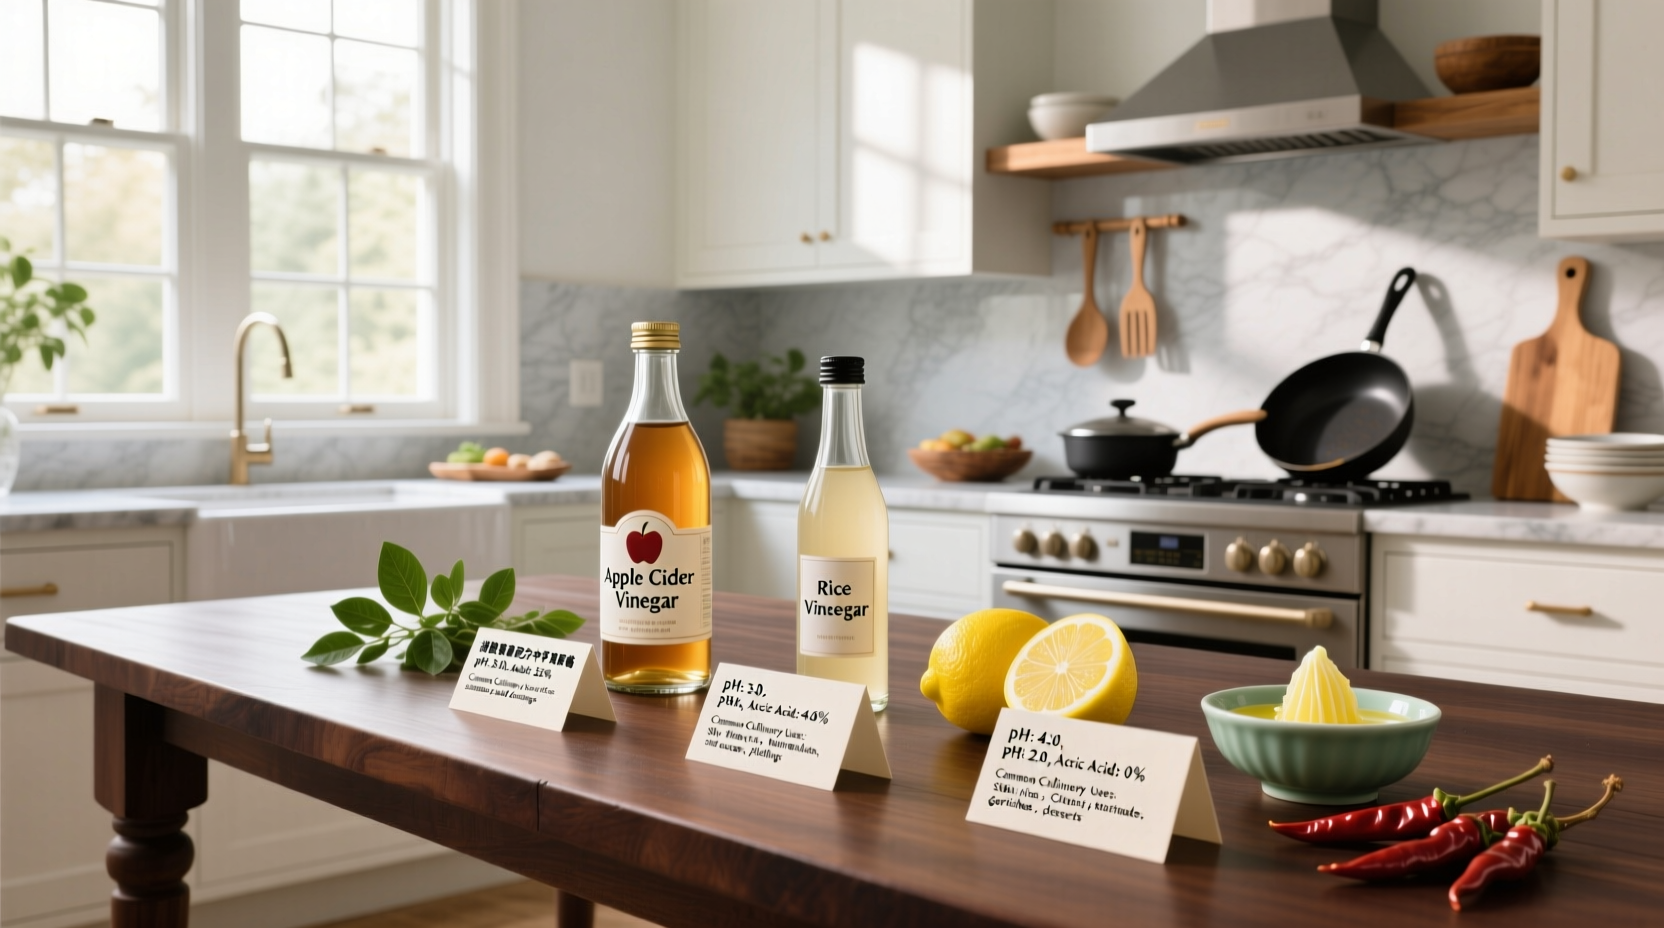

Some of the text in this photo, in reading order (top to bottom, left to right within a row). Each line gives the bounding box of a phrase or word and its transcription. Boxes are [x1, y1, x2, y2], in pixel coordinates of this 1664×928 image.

[604, 567, 695, 590] Apple Cider
[817, 580, 852, 596] Rice
[615, 591, 679, 613] Vinegar
[1007, 727, 1034, 743] pH:
[1087, 759, 1120, 777] Acid:
